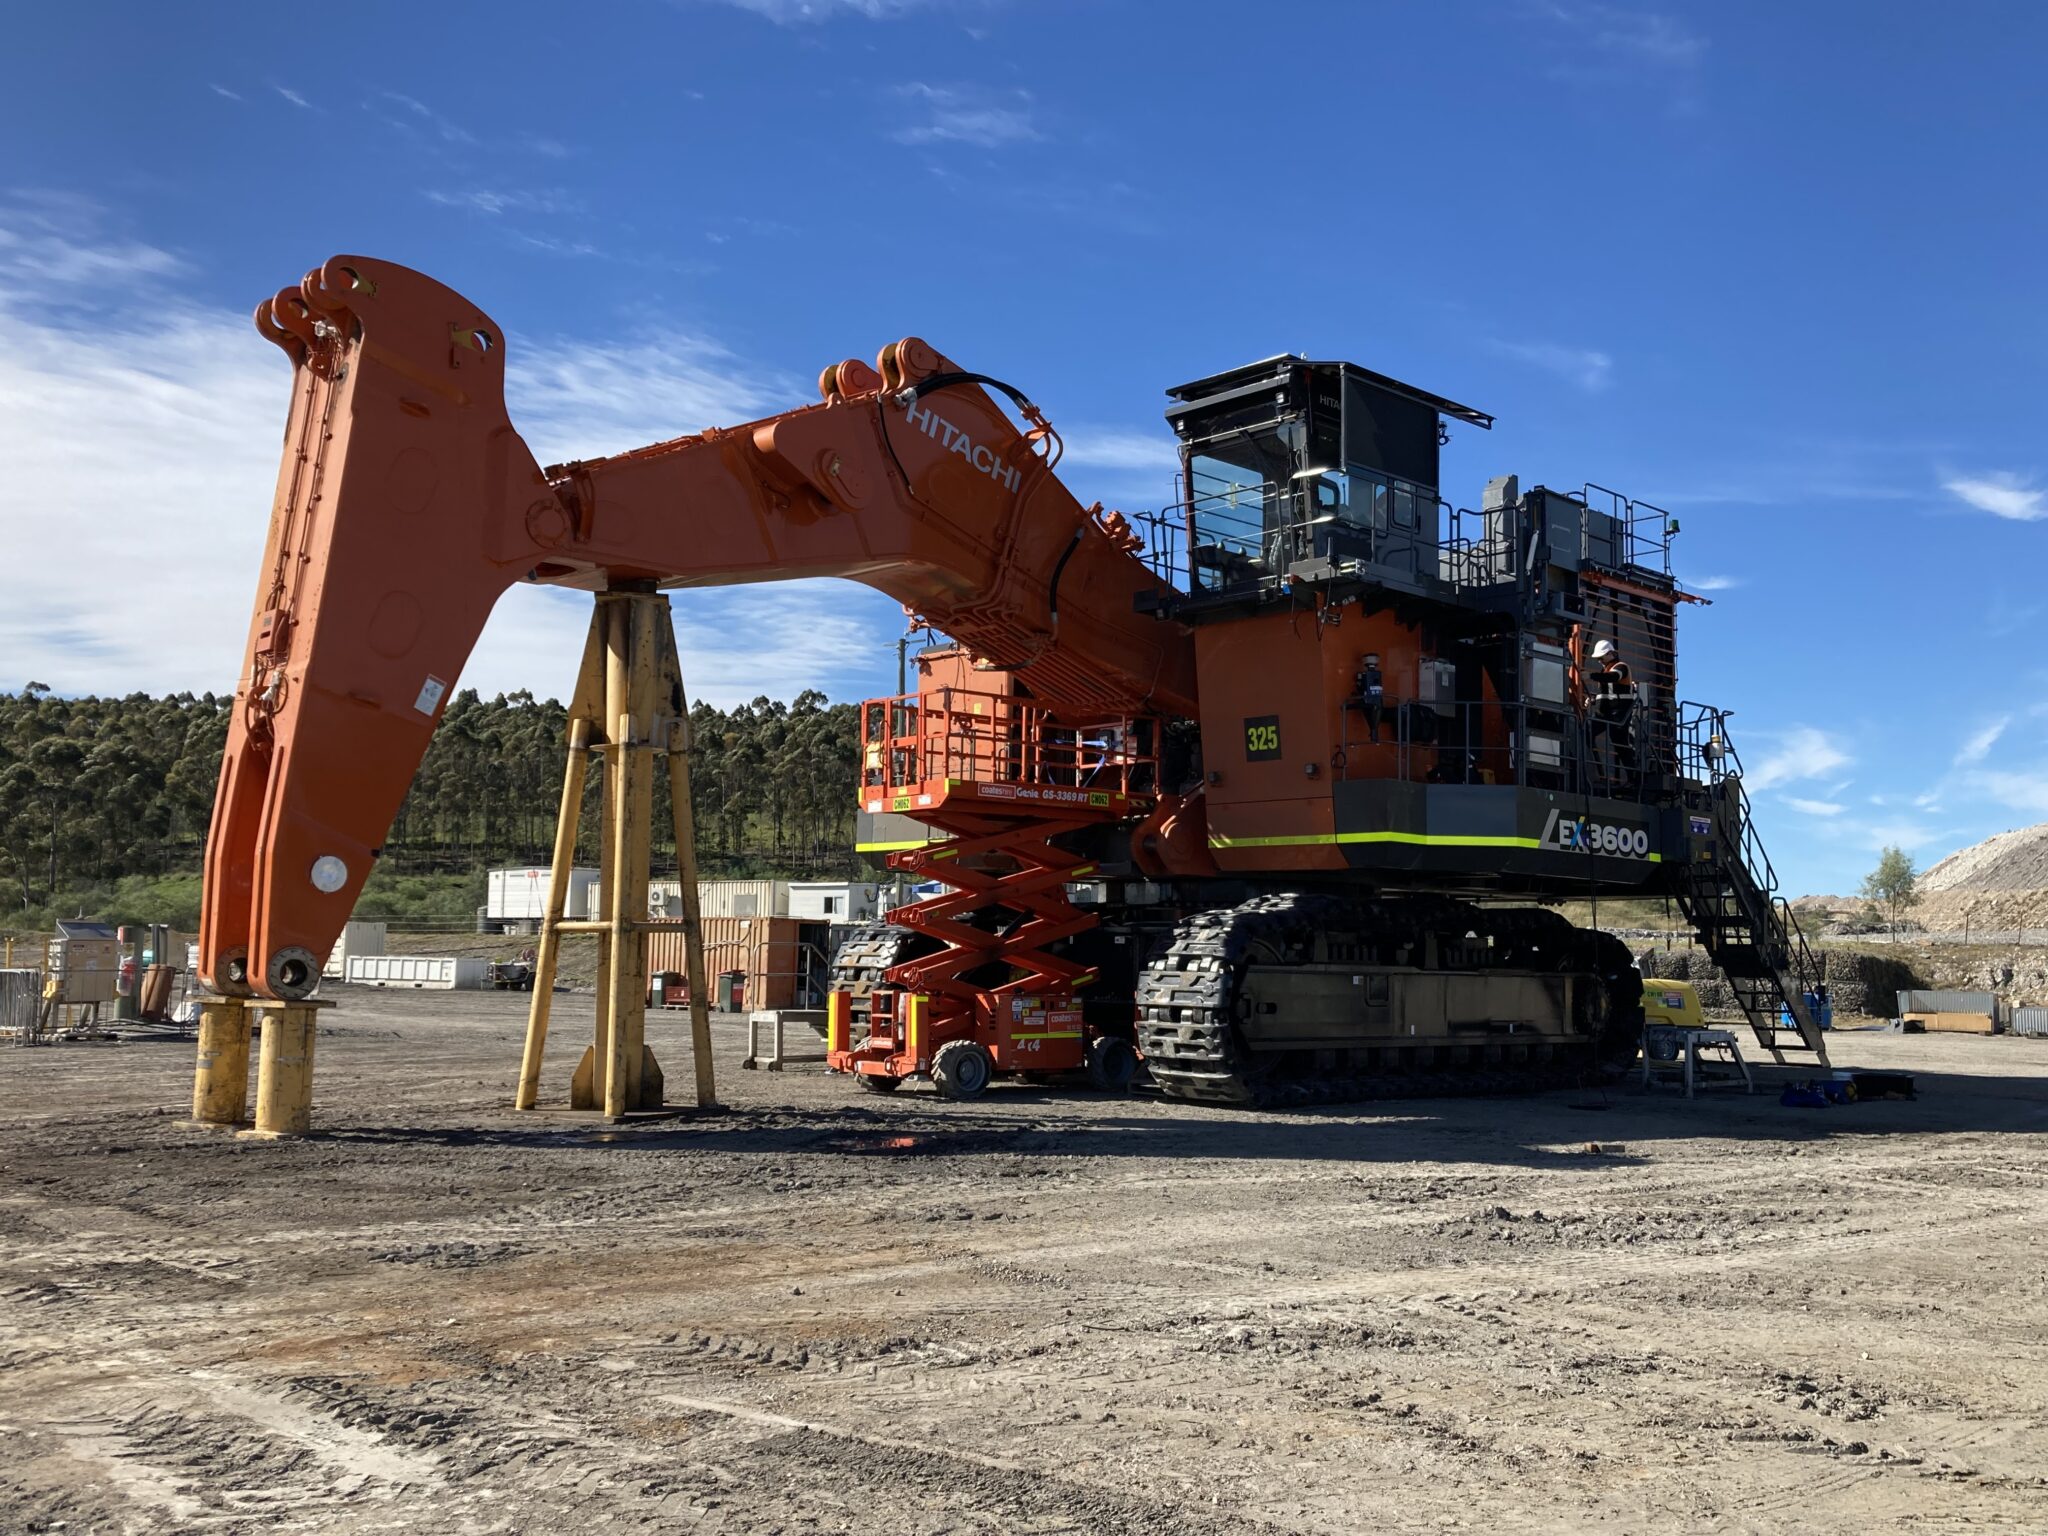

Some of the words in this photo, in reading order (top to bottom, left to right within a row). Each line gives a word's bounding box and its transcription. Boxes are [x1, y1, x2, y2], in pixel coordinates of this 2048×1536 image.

[1320, 394, 1341, 410] HITA
[906, 402, 1021, 494] HITACHI
[1248, 726, 1277, 751] 325
[1016, 787, 1039, 799] Genie
[1077, 792, 1089, 803] RT
